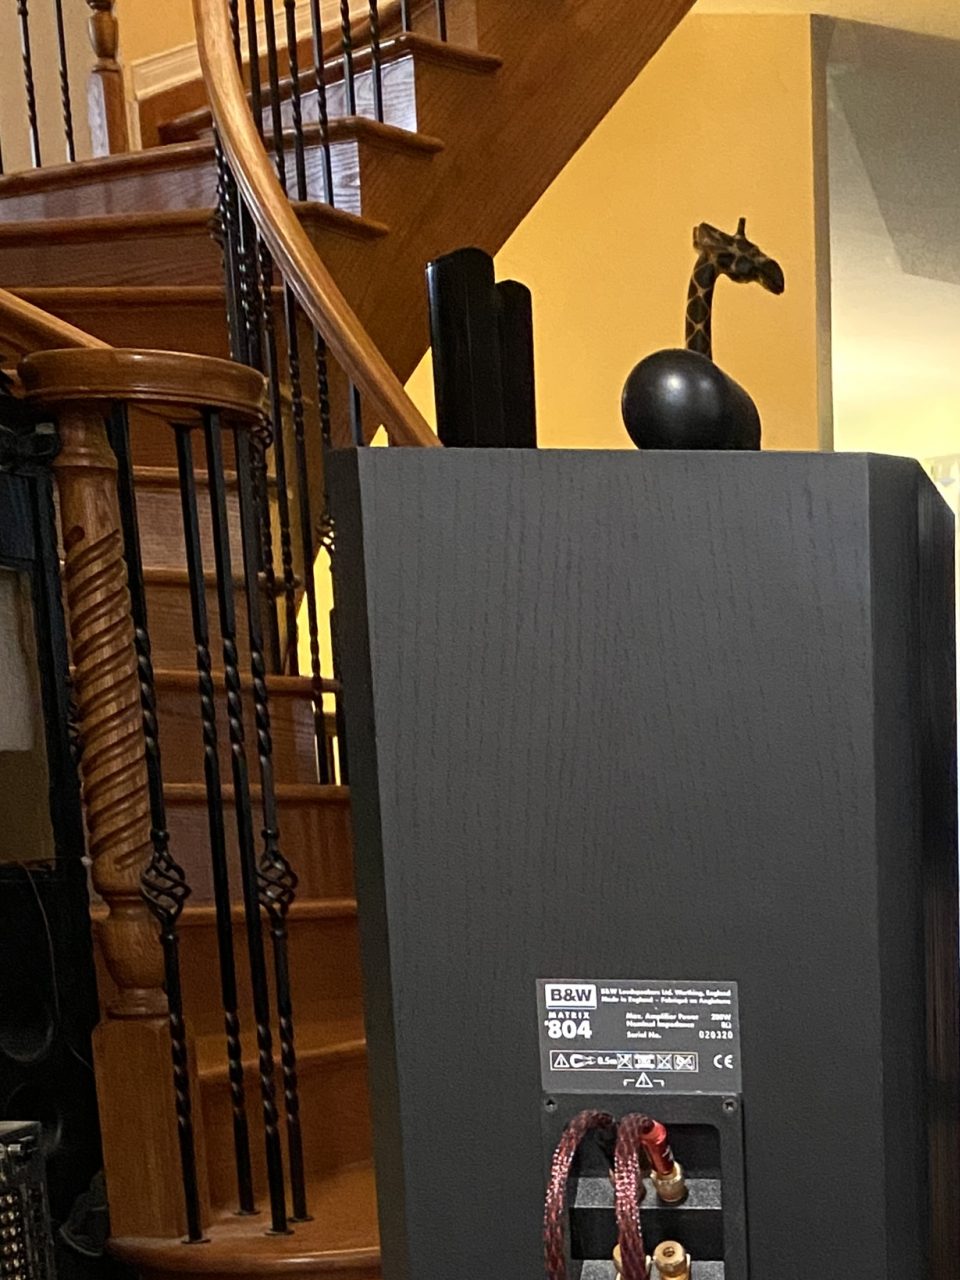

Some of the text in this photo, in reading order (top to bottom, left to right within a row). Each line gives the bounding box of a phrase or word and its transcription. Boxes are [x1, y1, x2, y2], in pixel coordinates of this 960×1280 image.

[551, 988, 592, 1002] B&W
[628, 996, 653, 1004] England
[548, 1011, 590, 1019] MATRIX
[645, 1012, 677, 1020] Amplifier
[657, 1021, 695, 1029] Impedance
[713, 1054, 734, 1069] CE
